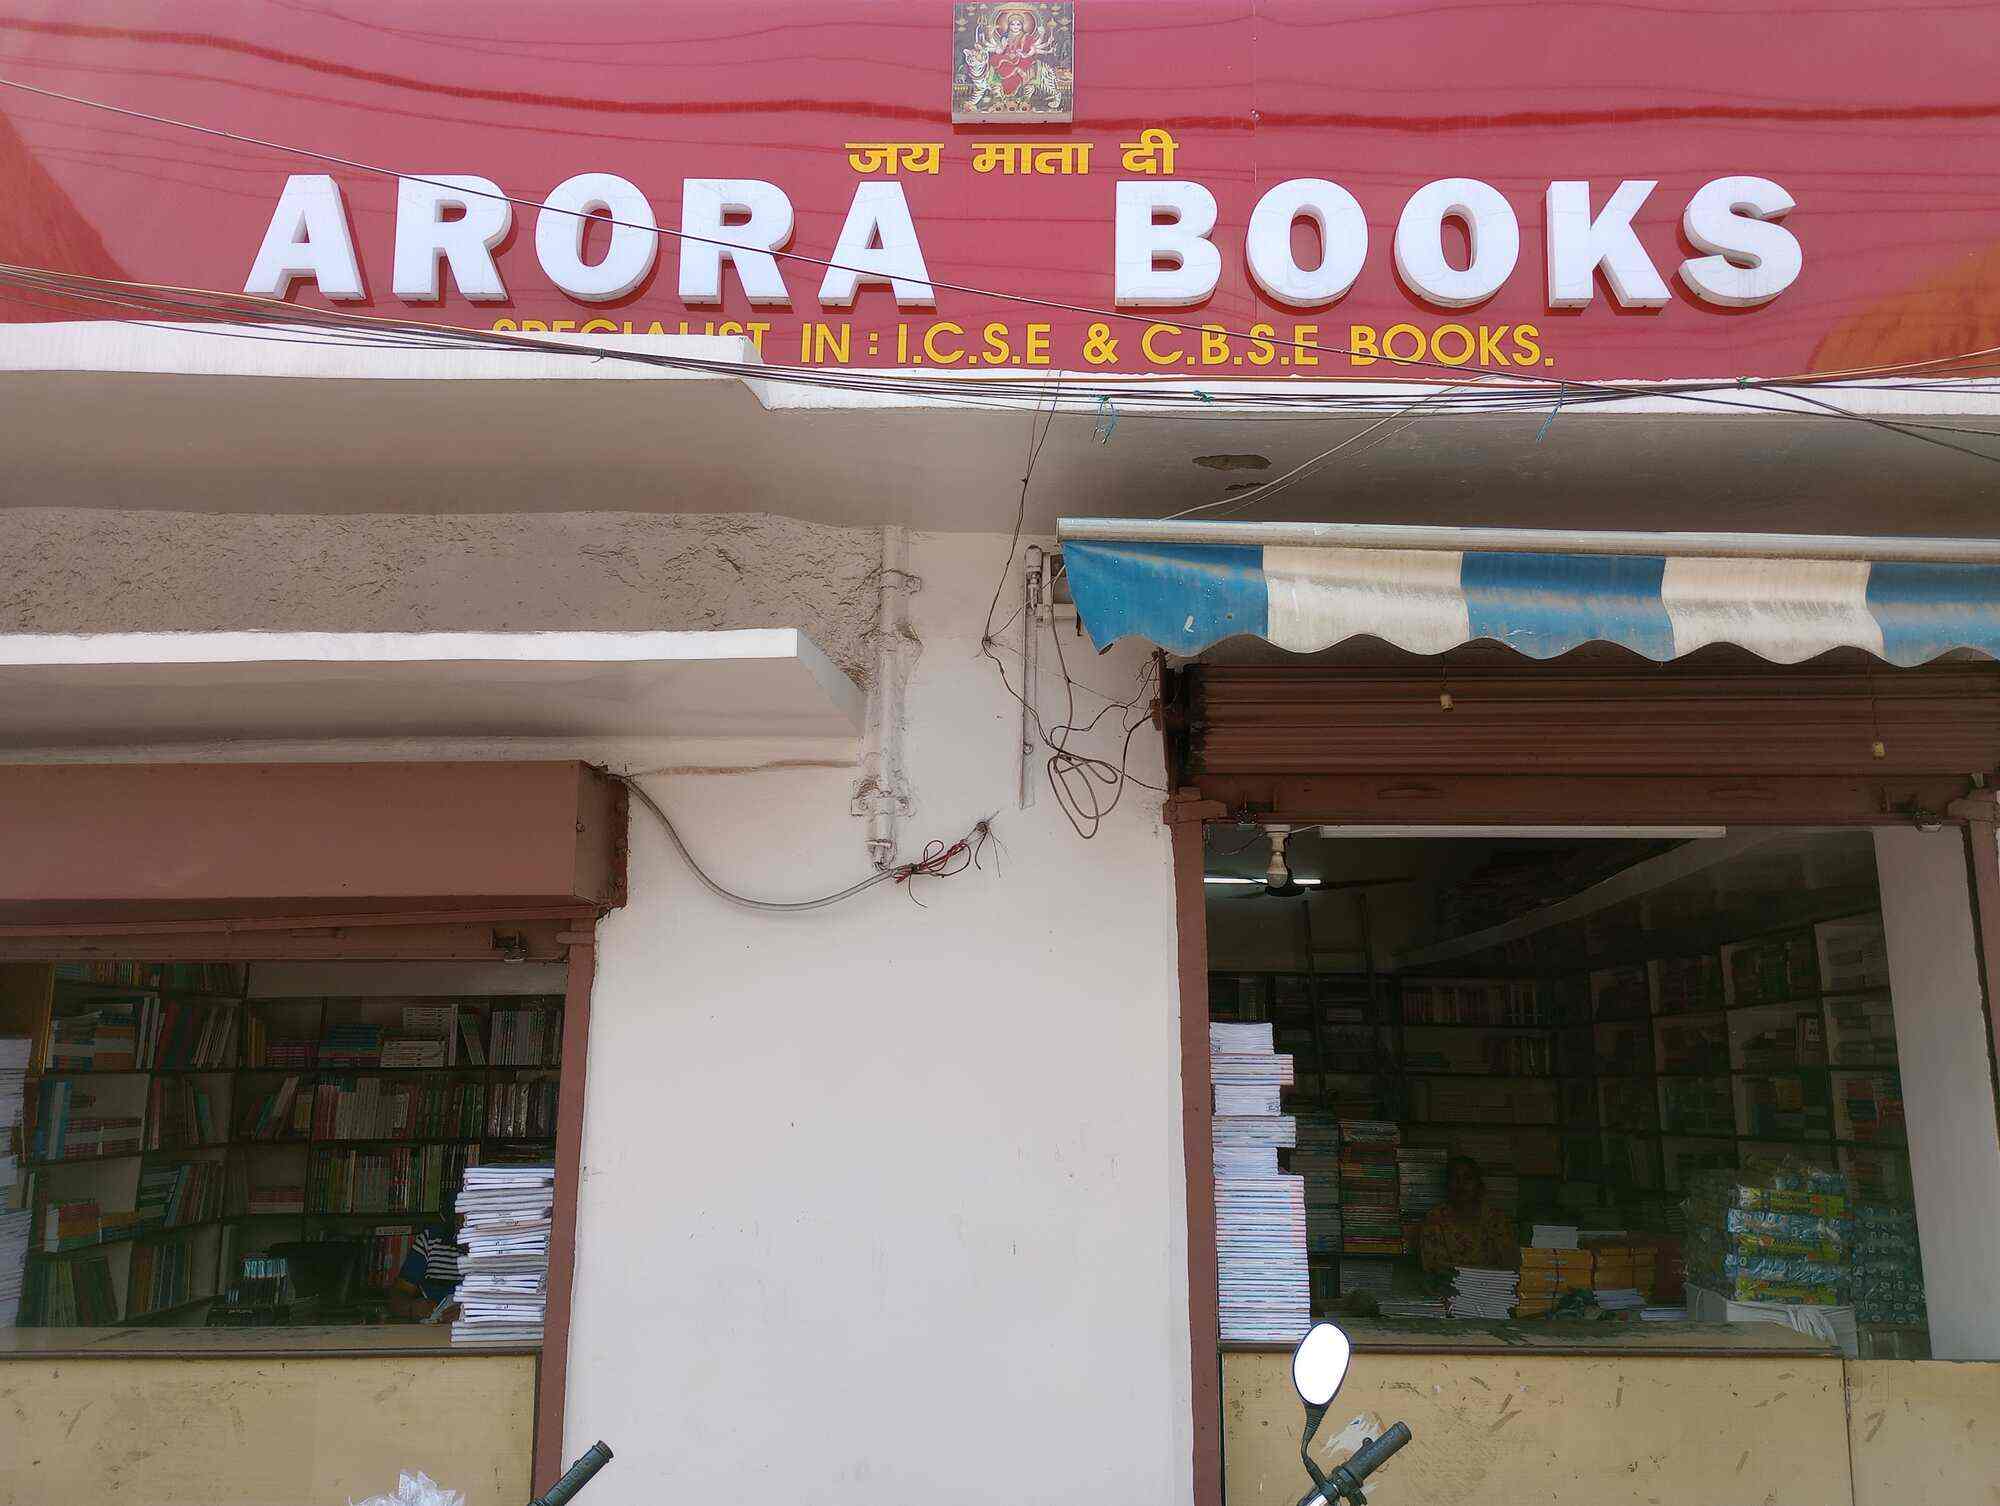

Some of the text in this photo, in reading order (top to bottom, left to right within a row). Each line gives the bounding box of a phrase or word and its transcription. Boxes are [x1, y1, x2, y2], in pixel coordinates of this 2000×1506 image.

[844, 128, 1179, 174] जय माता दी
[243, 172, 1802, 309] ARORA BOOKS
[897, 322, 1050, 364] I.C.S.E
[1083, 322, 1118, 364] &
[1141, 323, 1319, 365] C.B.S.E
[1350, 323, 1554, 366] BOOKS.
